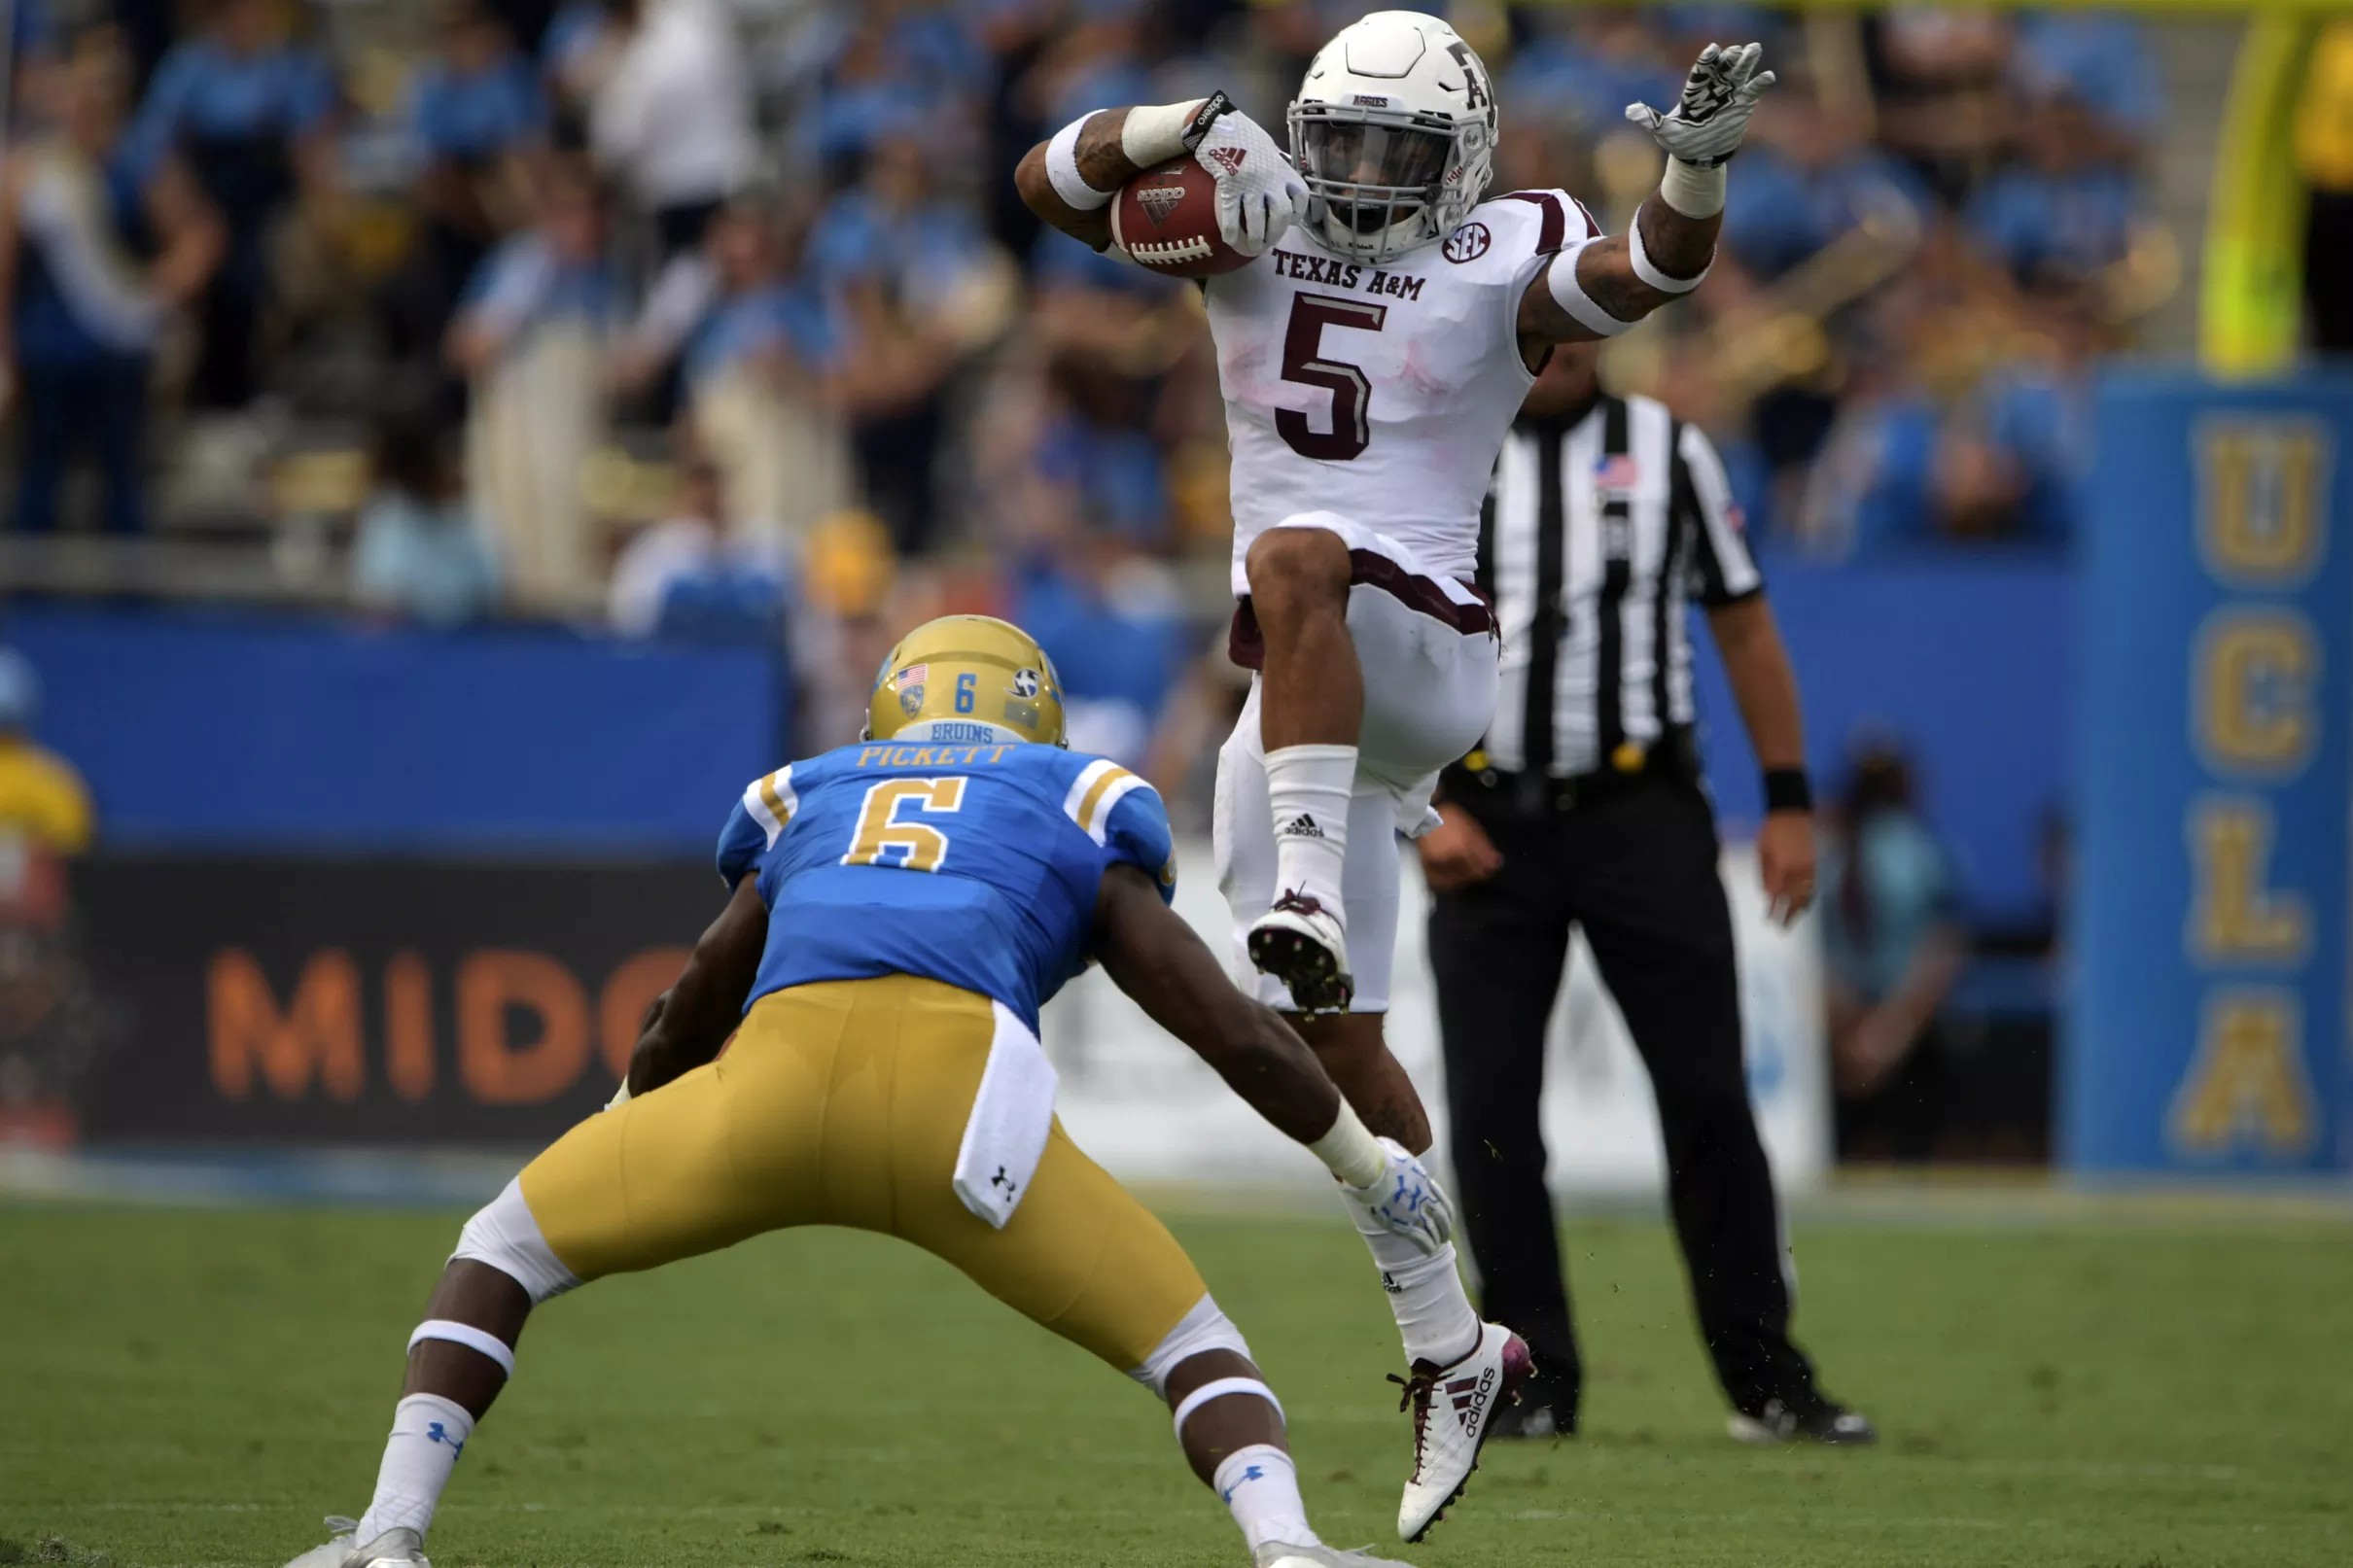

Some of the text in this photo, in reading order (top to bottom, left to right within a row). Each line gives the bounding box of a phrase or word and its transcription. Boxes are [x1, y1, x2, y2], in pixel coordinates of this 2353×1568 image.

[1197, 94, 1224, 125] adizero
[1209, 149, 1239, 176] adidas
[1137, 187, 1185, 202] adidas
[1443, 223, 1489, 263] SEC
[1272, 248, 1426, 301] TEXAS A&M
[1275, 291, 1388, 461] 5
[954, 673, 976, 714] 6
[931, 722, 994, 745] BRUINS
[856, 745, 1016, 768] PICKETT
[2174, 423, 2324, 1155] UCLA
[840, 776, 968, 873] 6
[1284, 825, 1325, 838] adidas
[1466, 1367, 1495, 1438] adidas
